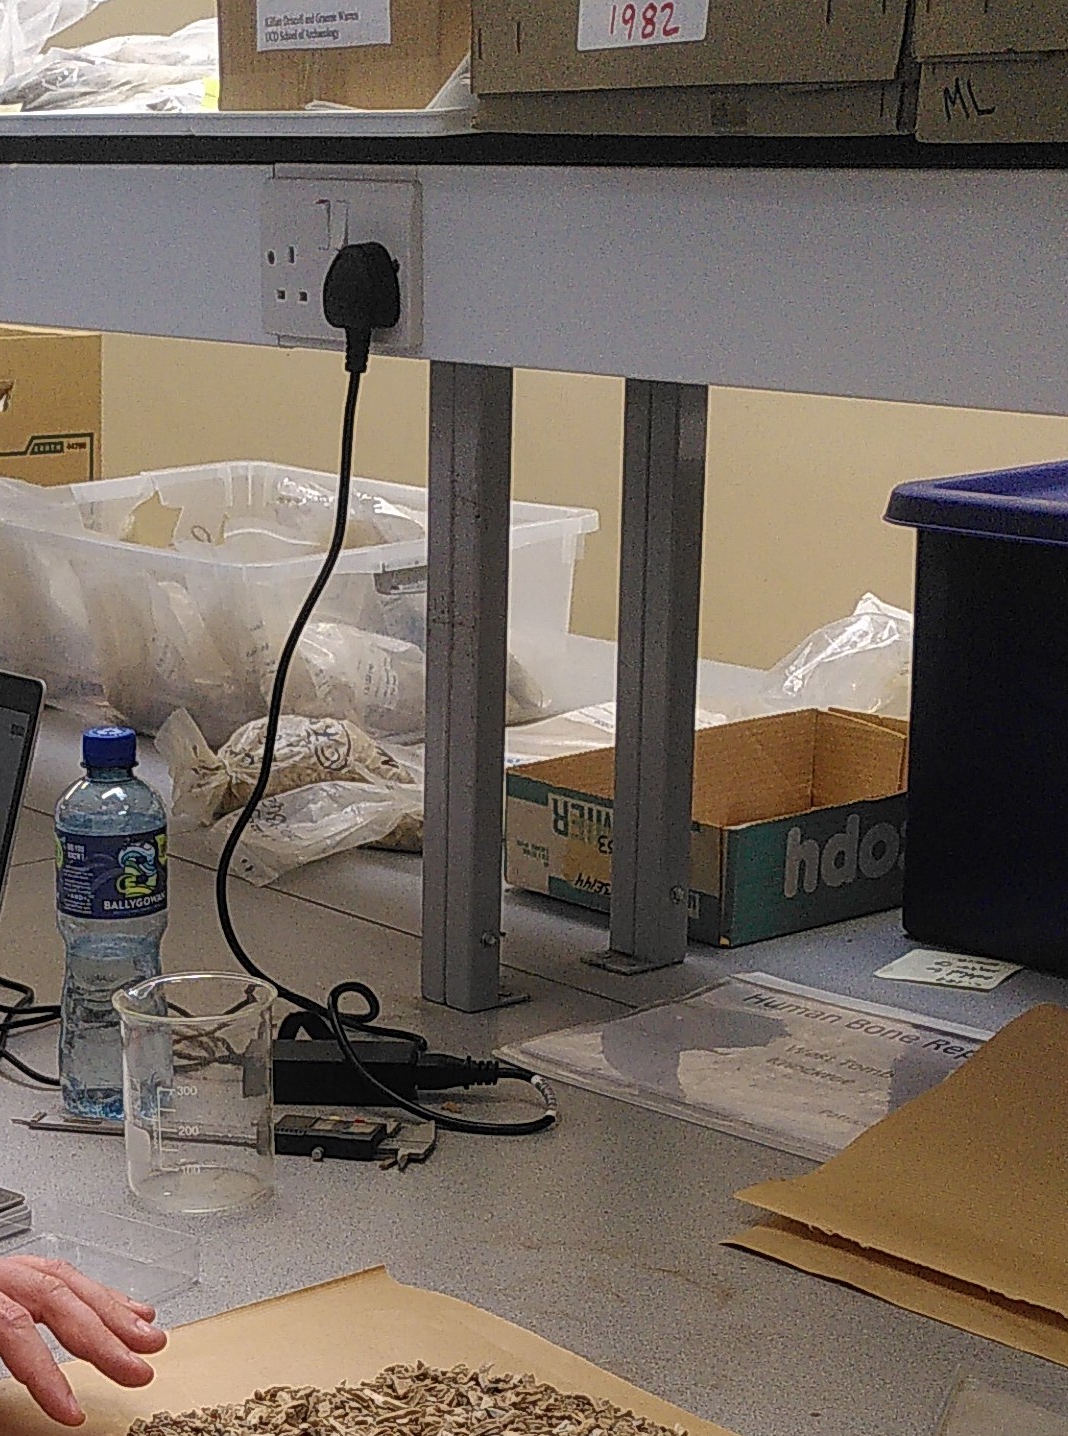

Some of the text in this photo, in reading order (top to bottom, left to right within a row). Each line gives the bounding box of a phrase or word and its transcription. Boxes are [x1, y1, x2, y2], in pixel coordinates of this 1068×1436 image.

[610, 2, 680, 40] 1982
[280, 30, 297, 41] School
[298, 30, 304, 39] of
[943, 77, 996, 122] ML
[743, 993, 842, 1025] Human
[844, 1017, 921, 1045] Bone
[839, 1056, 897, 1080] Tomb
[176, 1085, 198, 1096] 300
[178, 1125, 199, 1136] 200
